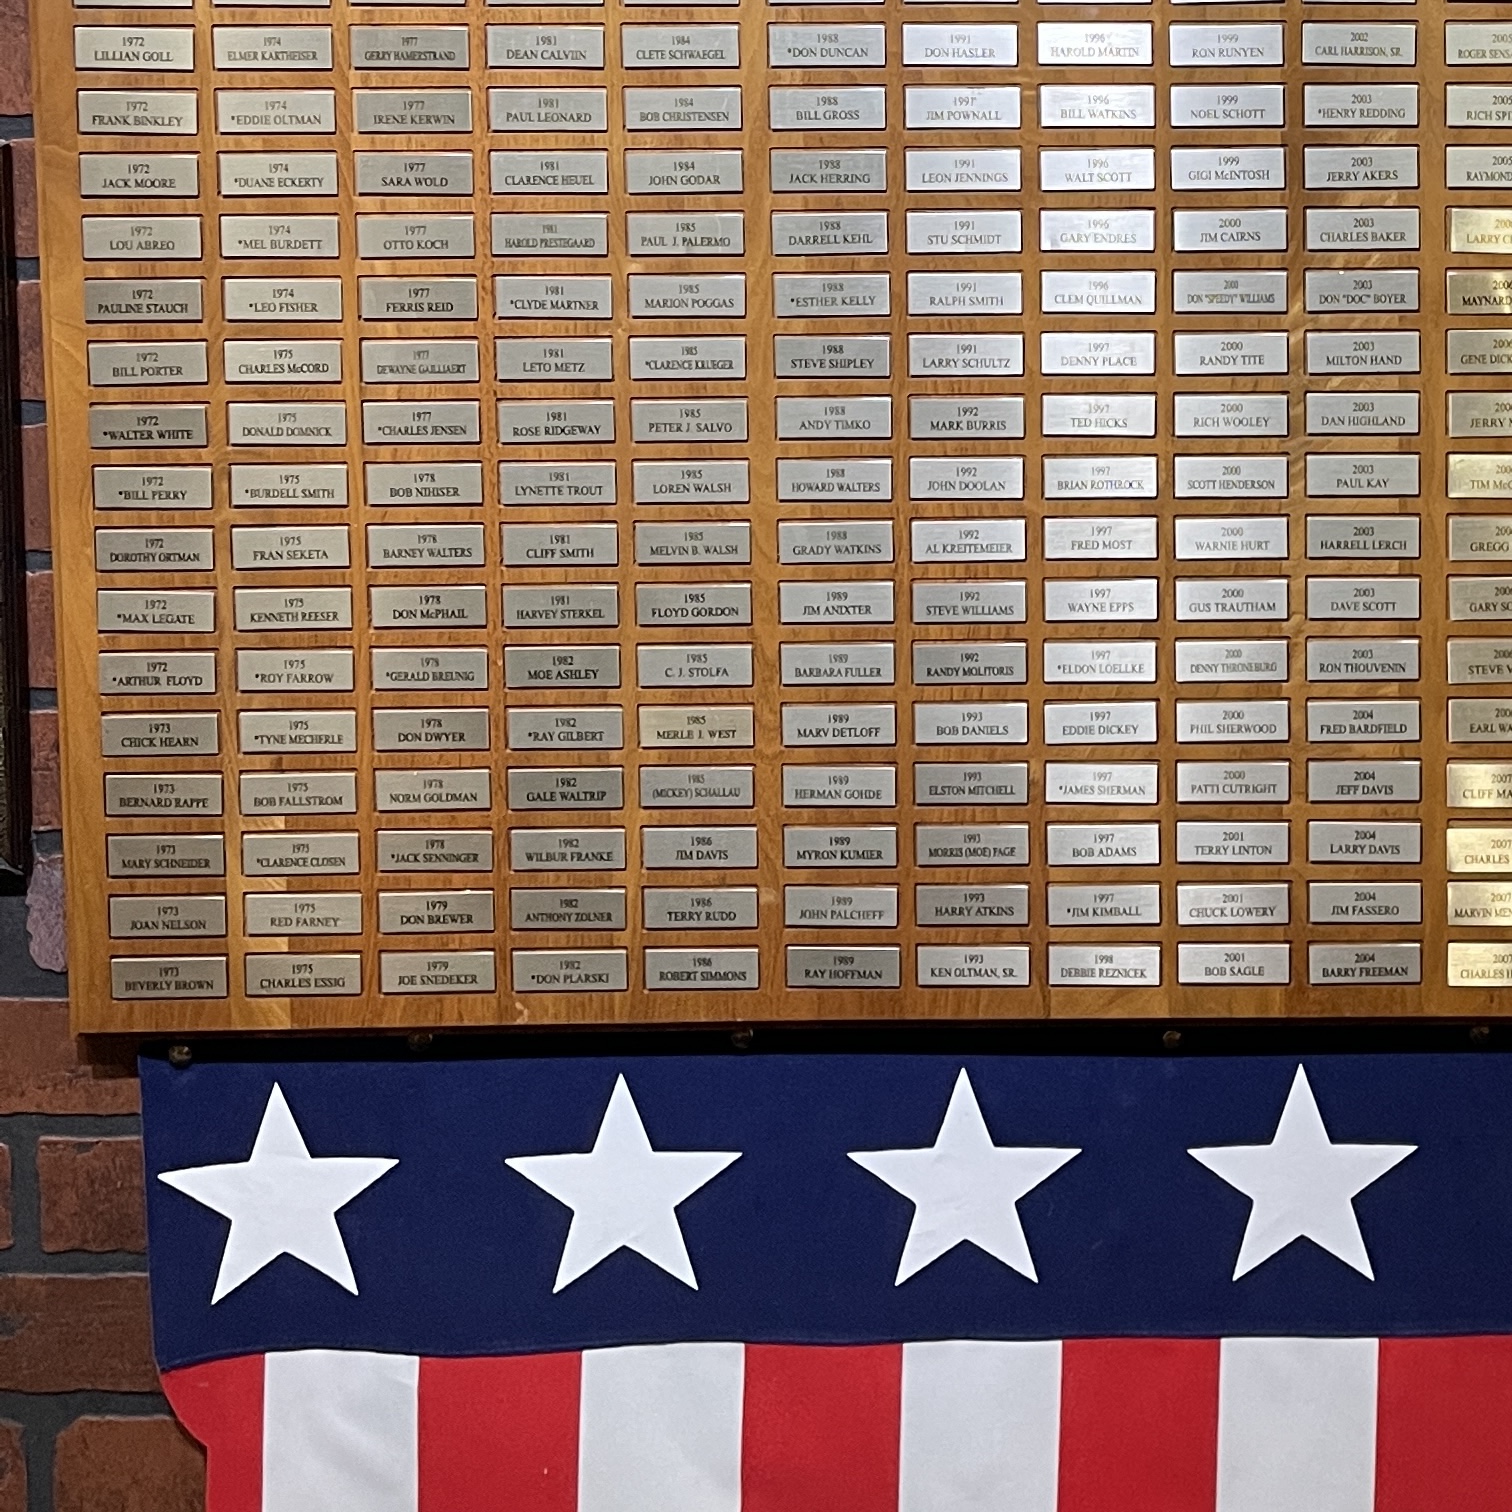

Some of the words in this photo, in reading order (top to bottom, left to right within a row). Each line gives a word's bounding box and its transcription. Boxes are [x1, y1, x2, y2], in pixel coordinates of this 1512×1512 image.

[123, 37, 144, 46] 1972
[94, 51, 140, 61] LILLIAN
[142, 51, 173, 61] GOLL
[404, 101, 424, 110] 1977
[374, 115, 407, 124] IRENE
[410, 115, 455, 124] KERWIN
[133, 289, 153, 299] 1972
[98, 304, 144, 313] PAULINE
[146, 304, 188, 313] STAUCH
[823, 345, 844, 354] 1988
[791, 359, 826, 368] STEVE
[829, 359, 874, 368] SHIPLEY
[958, 407, 978, 416] 1992
[930, 421, 964, 430] MARK
[967, 421, 1006, 430] BURRIS
[1091, 526, 1112, 536] 1997
[280, 536, 301, 546] 1975
[1071, 540, 1099, 550] FRED
[1102, 540, 1133, 550] MOST
[253, 550, 283, 560] FRAN
[287, 550, 328, 560] SEKETA
[419, 595, 441, 605] 1978
[393, 609, 417, 619] DON
[420, 609, 468, 619] McPHAIL
[553, 656, 574, 665] 1982
[528, 669, 553, 679] MOE
[555, 669, 599, 679] ASHLEY
[1470, 723, 1496, 733] EARL
[1223, 832, 1244, 841] 2001
[1195, 845, 1229, 855] TERRY
[1232, 845, 1272, 855] LINTON
[1355, 953, 1375, 963] 2004
[159, 967, 180, 977] 1973
[1322, 967, 1356, 978] BARRY
[1359, 966, 1409, 977] FREEMAN
[125, 981, 172, 990] BEVERLY
[175, 981, 214, 990] BROWN
